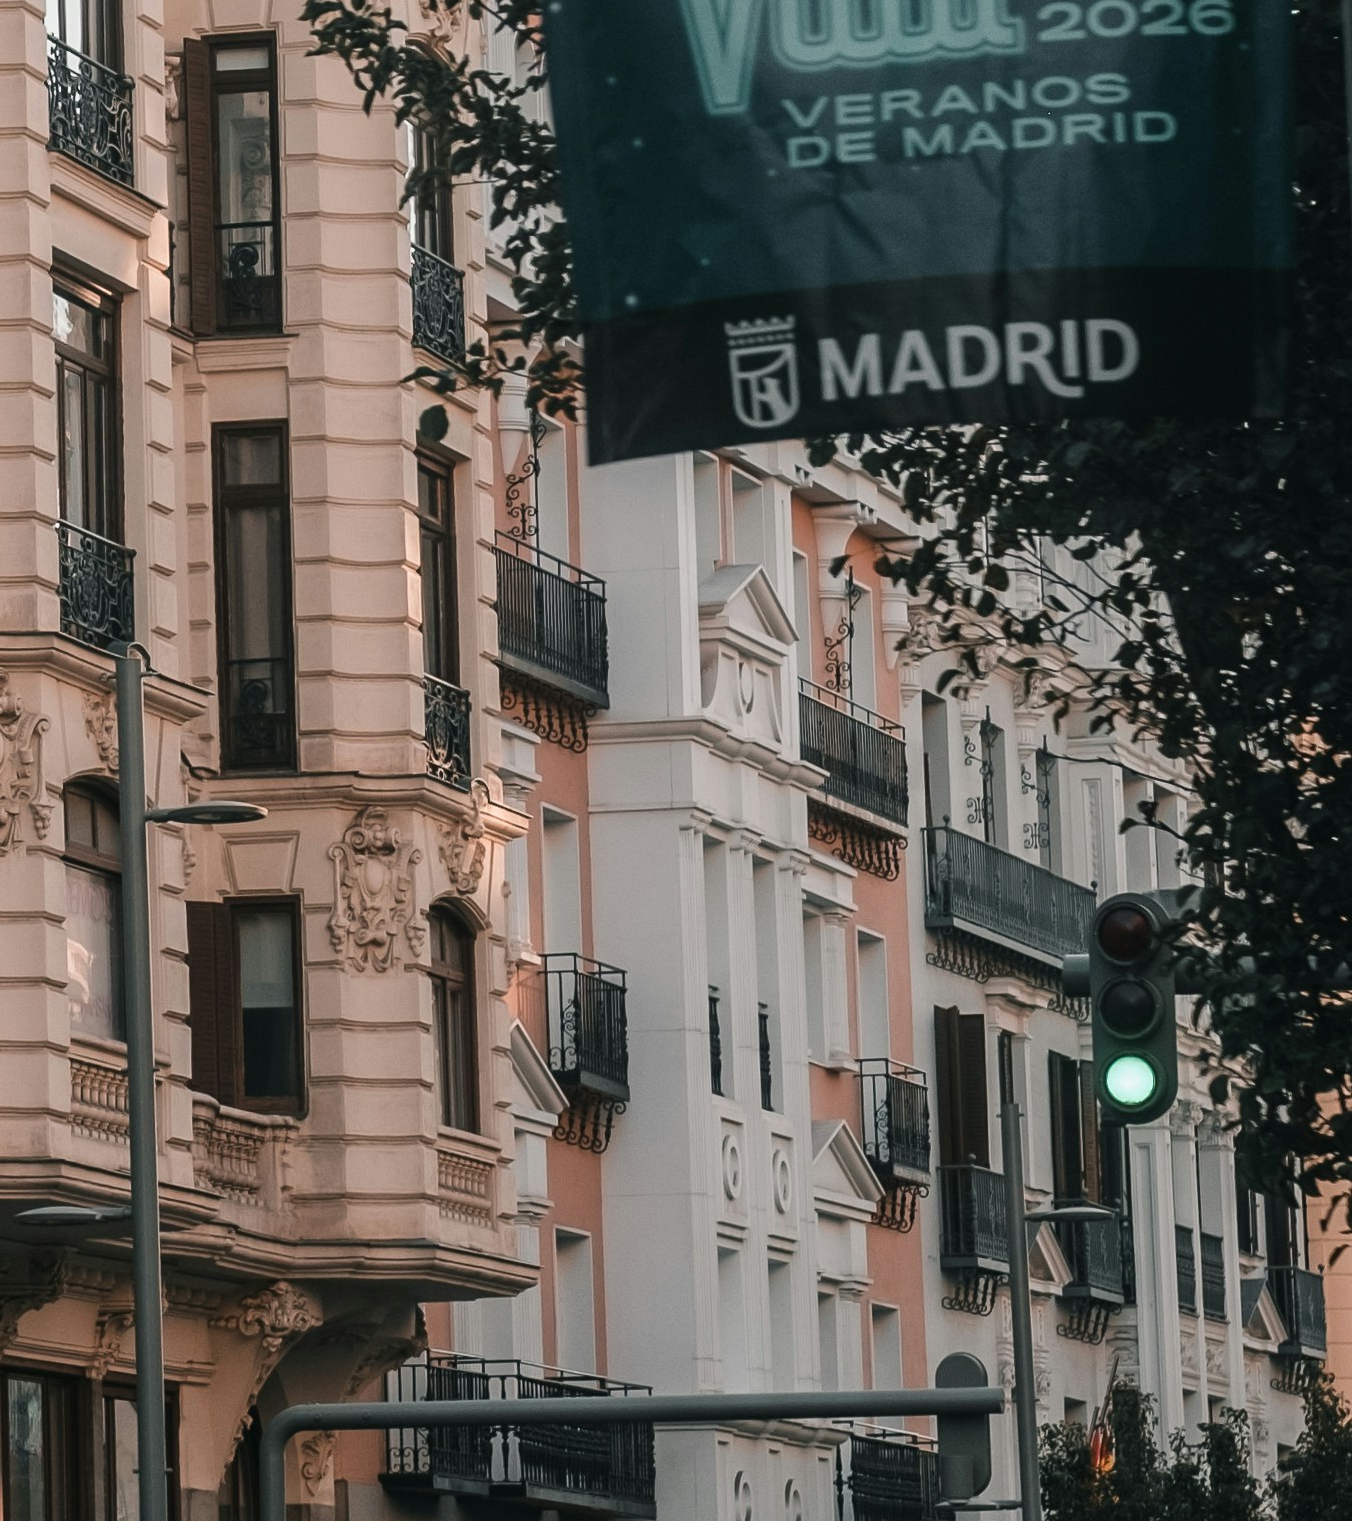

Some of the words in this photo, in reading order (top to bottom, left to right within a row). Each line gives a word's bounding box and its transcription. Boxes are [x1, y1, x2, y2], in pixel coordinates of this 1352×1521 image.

[783, 74, 1131, 128] VERANOS
[789, 132, 877, 167] DE
[902, 110, 1177, 157] MADRID
[819, 318, 1140, 401] MADRID
